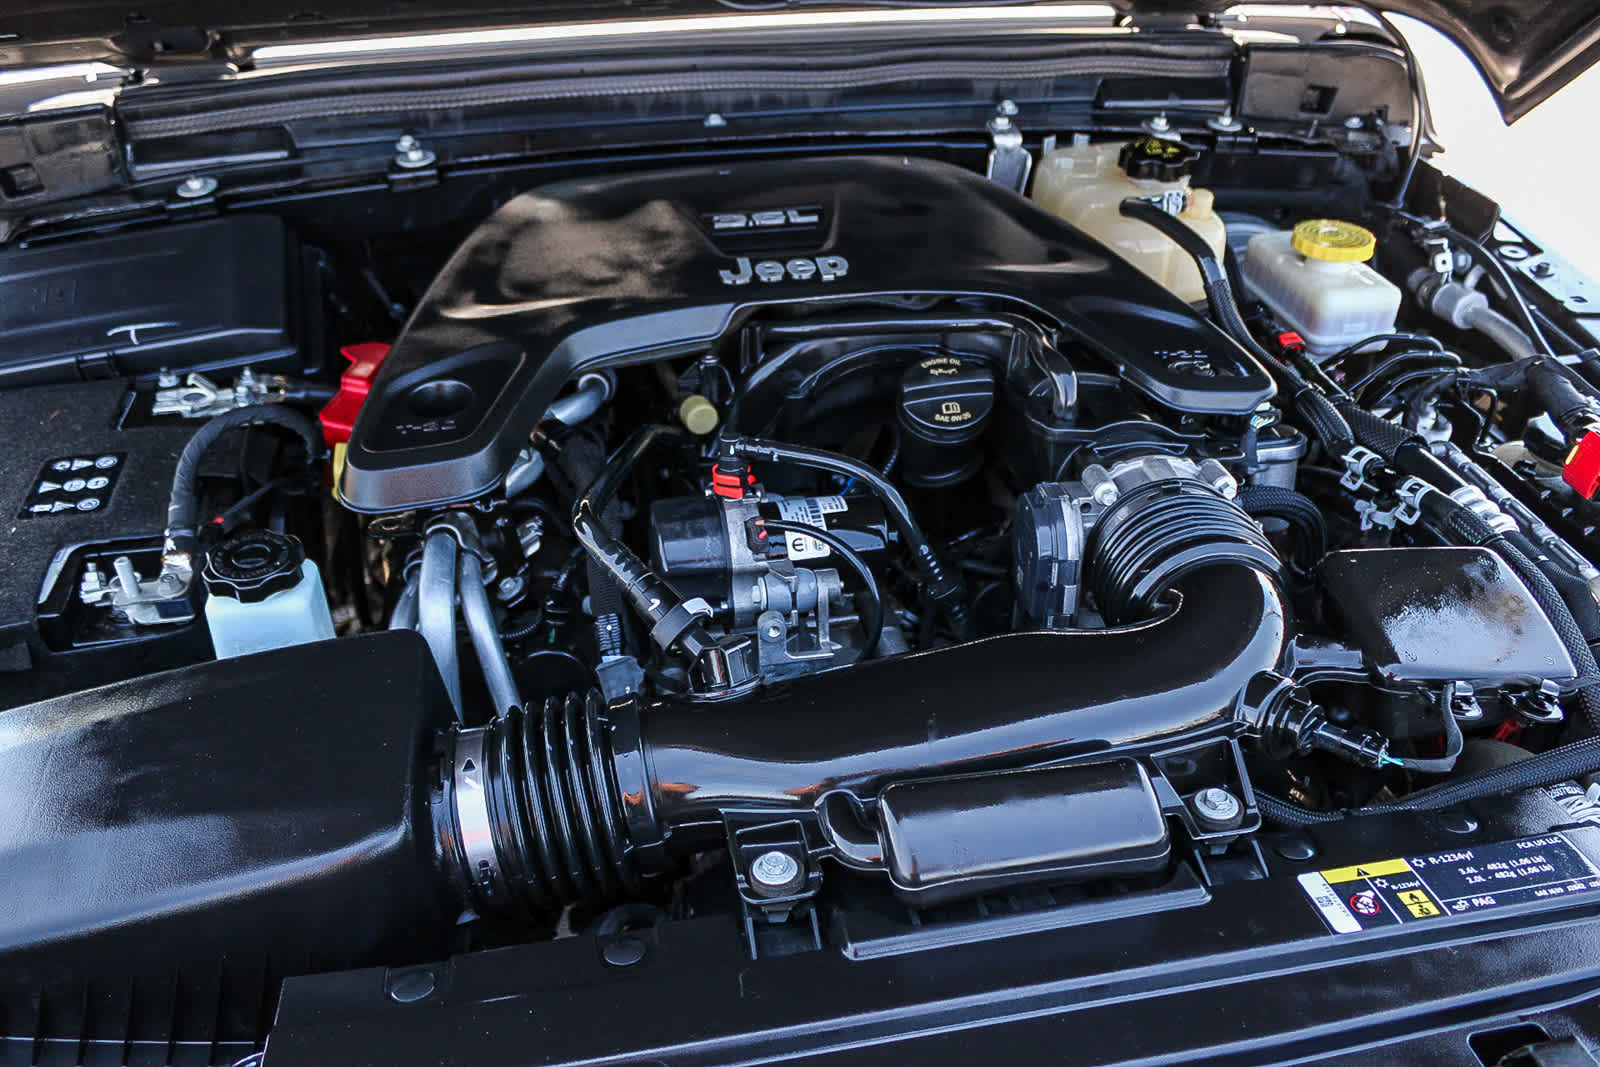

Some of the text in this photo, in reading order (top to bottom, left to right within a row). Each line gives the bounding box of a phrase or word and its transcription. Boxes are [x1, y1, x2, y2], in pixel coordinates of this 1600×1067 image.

[718, 255, 849, 286] Jeep
[920, 358, 961, 369] ENGINE OIL
[934, 413, 950, 423] SAE
[1516, 836, 1562, 850] FCA US LLC
[1428, 850, 1475, 865] R-1234yf
[1471, 896, 1497, 907] PAG
